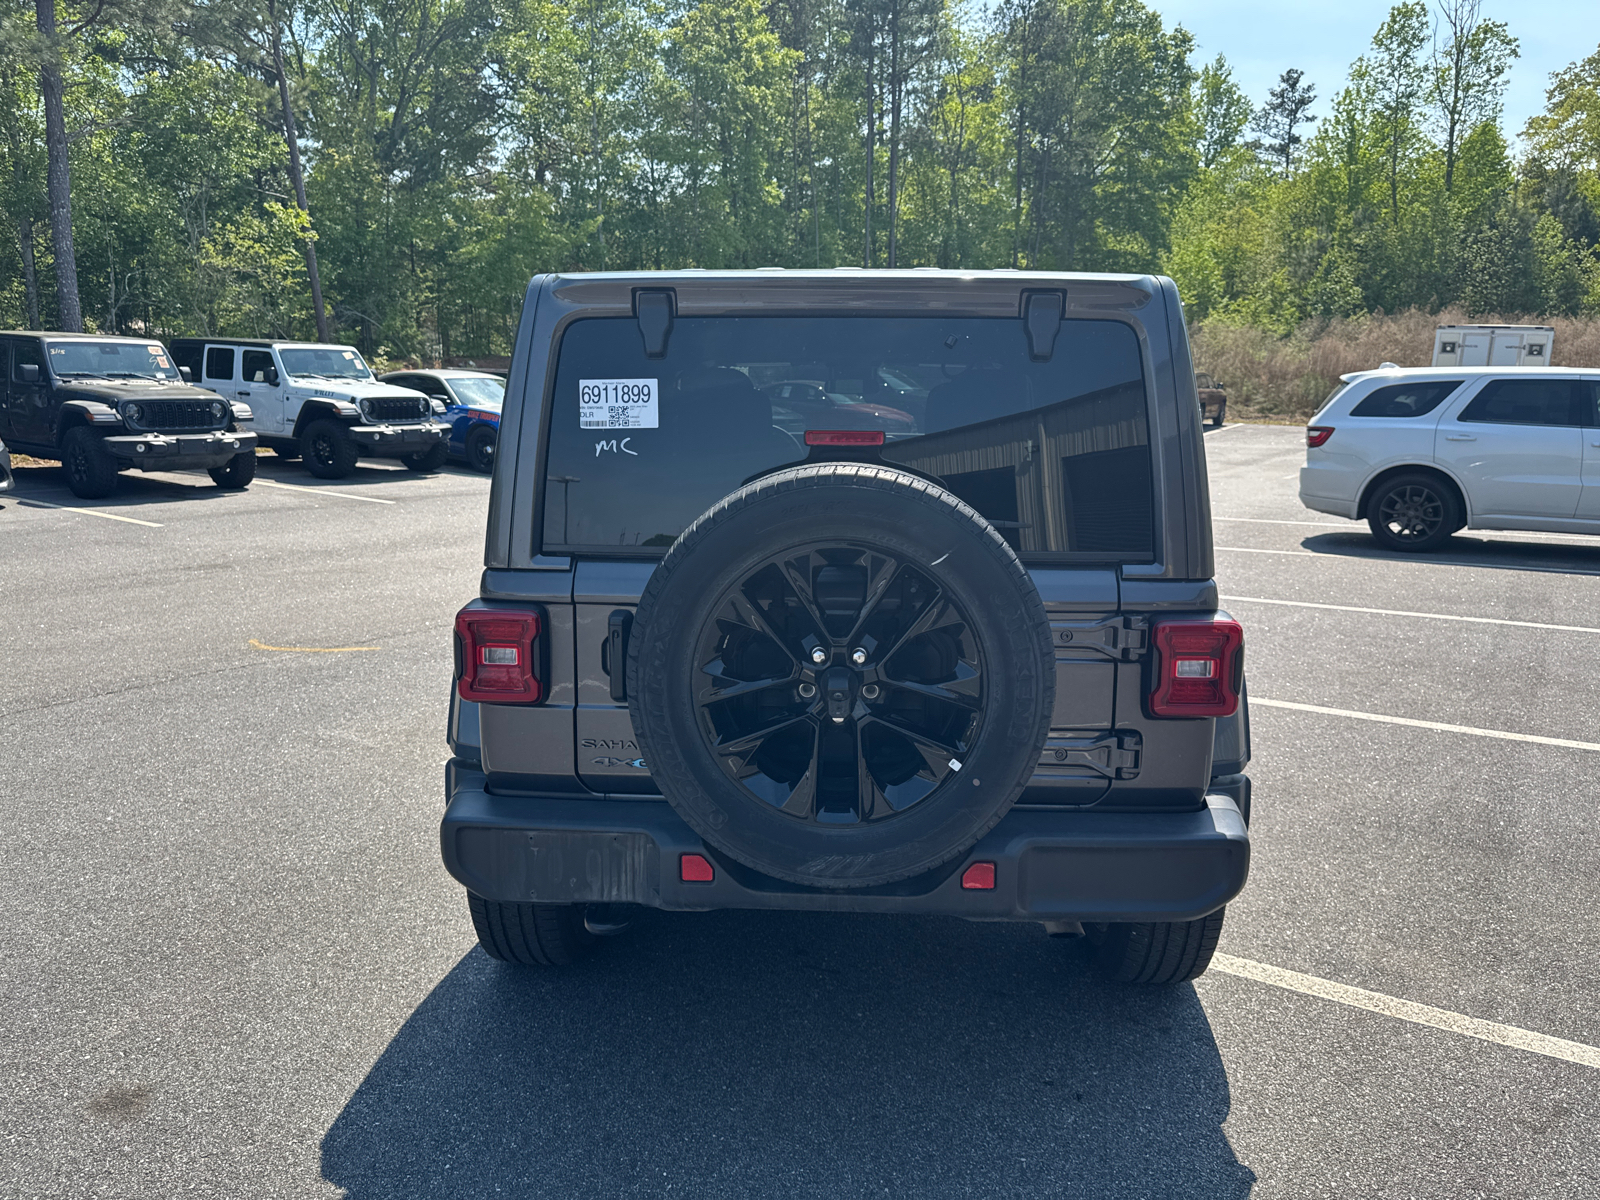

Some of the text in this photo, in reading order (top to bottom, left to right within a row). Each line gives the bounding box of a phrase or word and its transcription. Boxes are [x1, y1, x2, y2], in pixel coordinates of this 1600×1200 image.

[581, 384, 651, 404] 6911899
[595, 437, 638, 458] MC
[581, 738, 639, 750] SAHA
